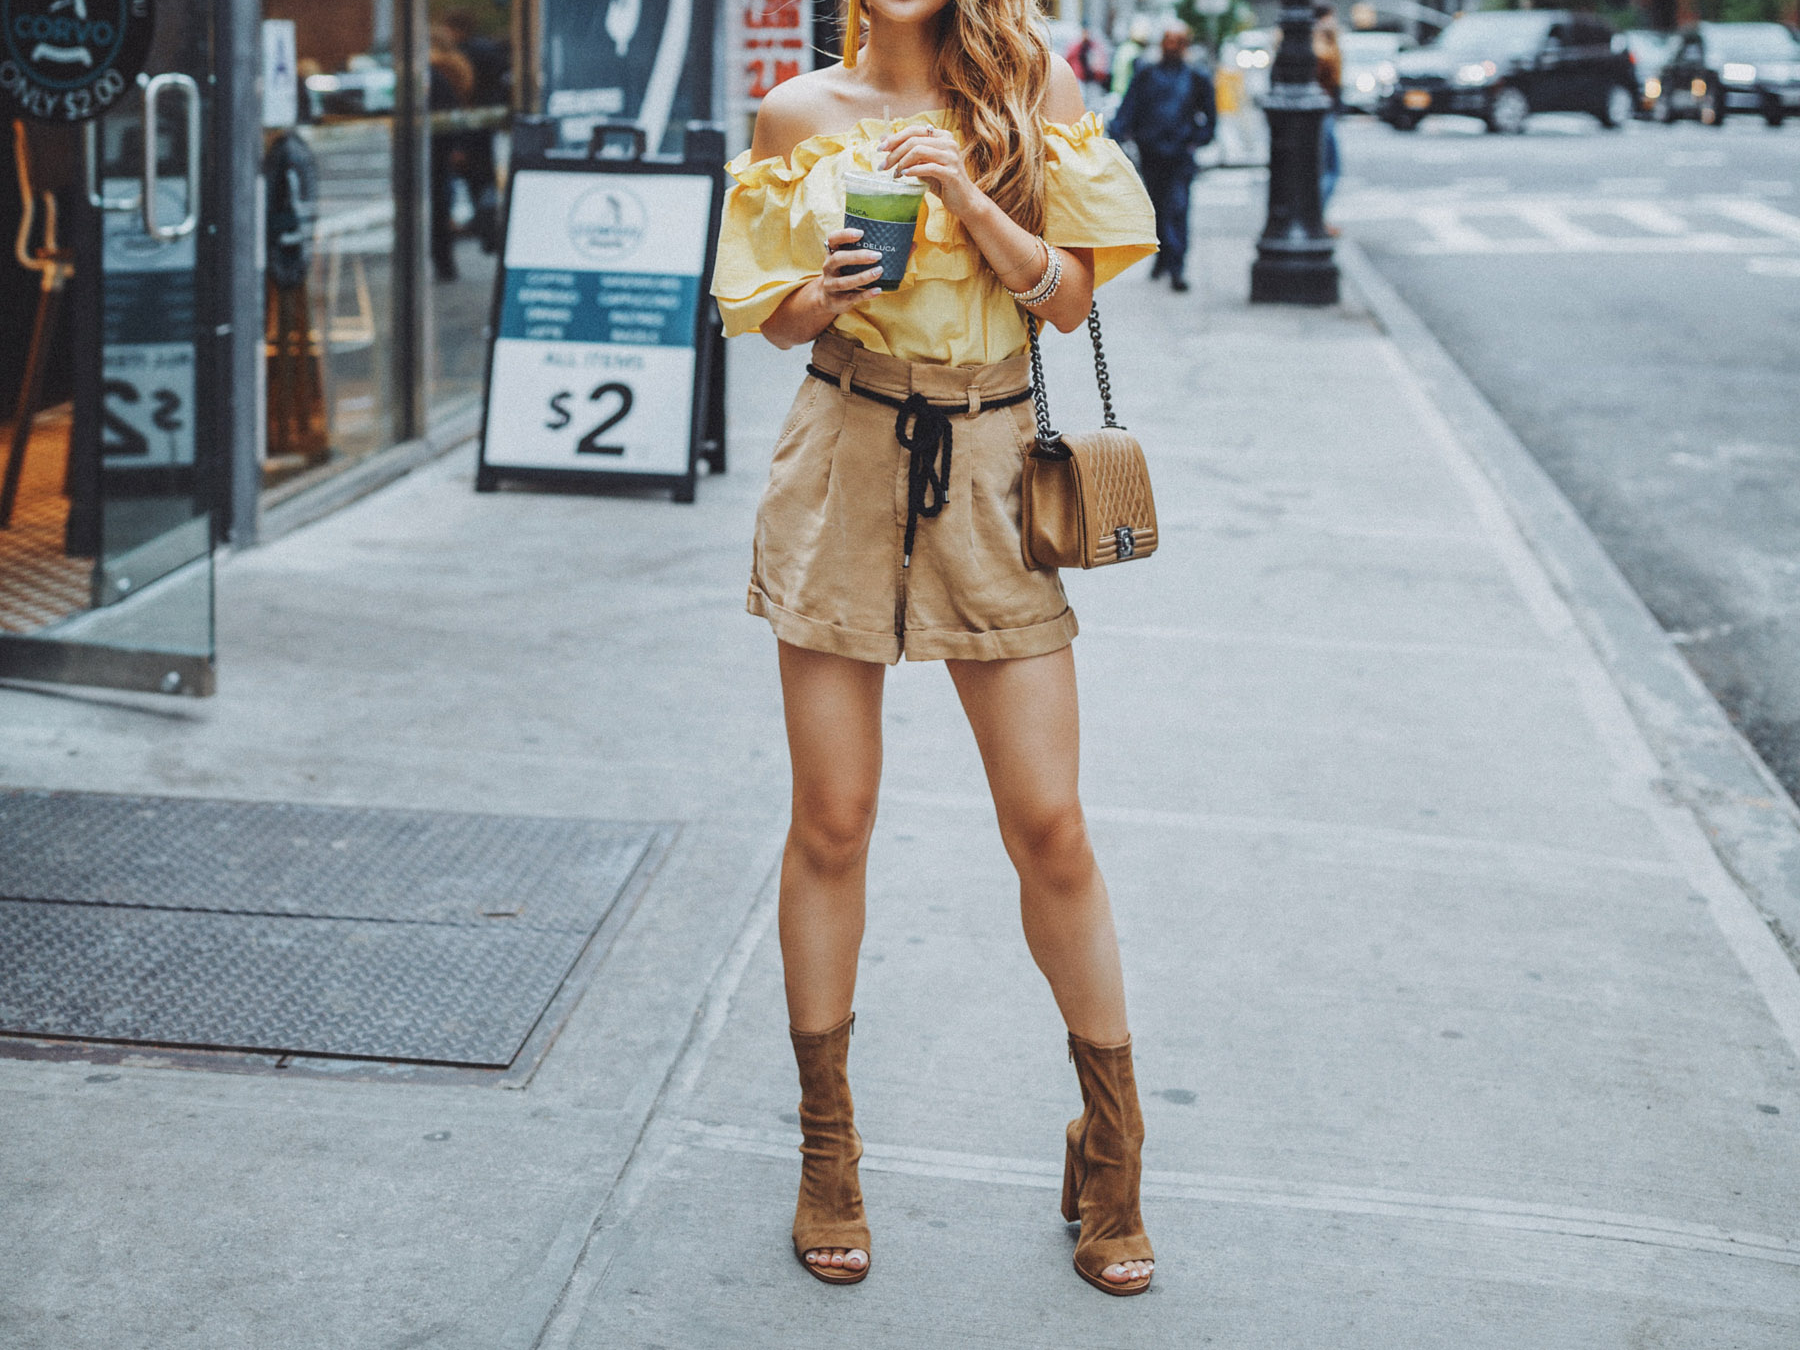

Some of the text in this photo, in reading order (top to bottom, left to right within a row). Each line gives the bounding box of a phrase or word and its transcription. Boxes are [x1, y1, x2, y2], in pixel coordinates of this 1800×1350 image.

[14, 14, 114, 47] CORVO
[0, 61, 57, 116] ONLY
[863, 242, 896, 251] DELUCA
[545, 383, 633, 457] $2
